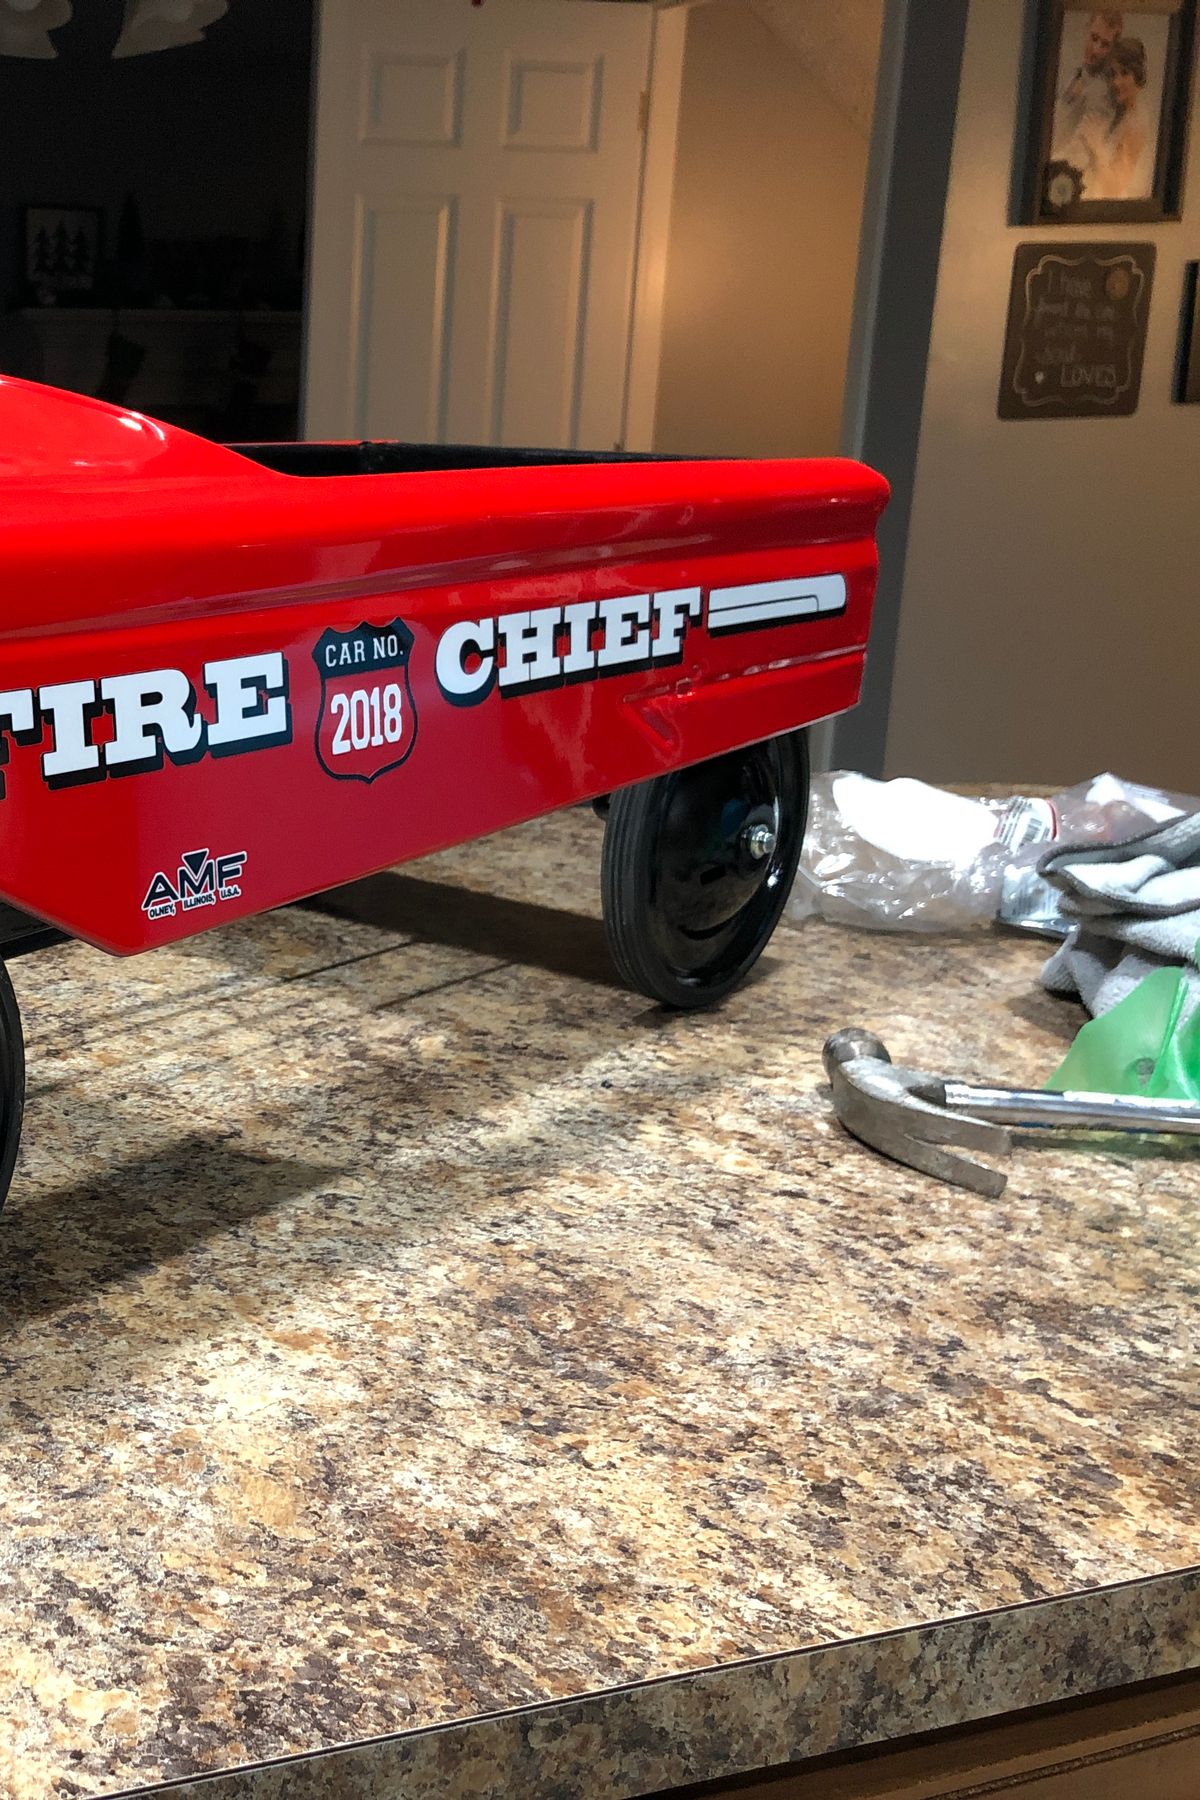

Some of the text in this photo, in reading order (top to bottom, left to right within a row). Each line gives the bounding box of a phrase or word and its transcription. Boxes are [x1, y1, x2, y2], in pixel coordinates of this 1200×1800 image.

[325, 634, 404, 668] CAR NO.
[436, 586, 701, 706] CHIEF
[330, 683, 403, 755] 2018
[141, 848, 247, 911] AMF
